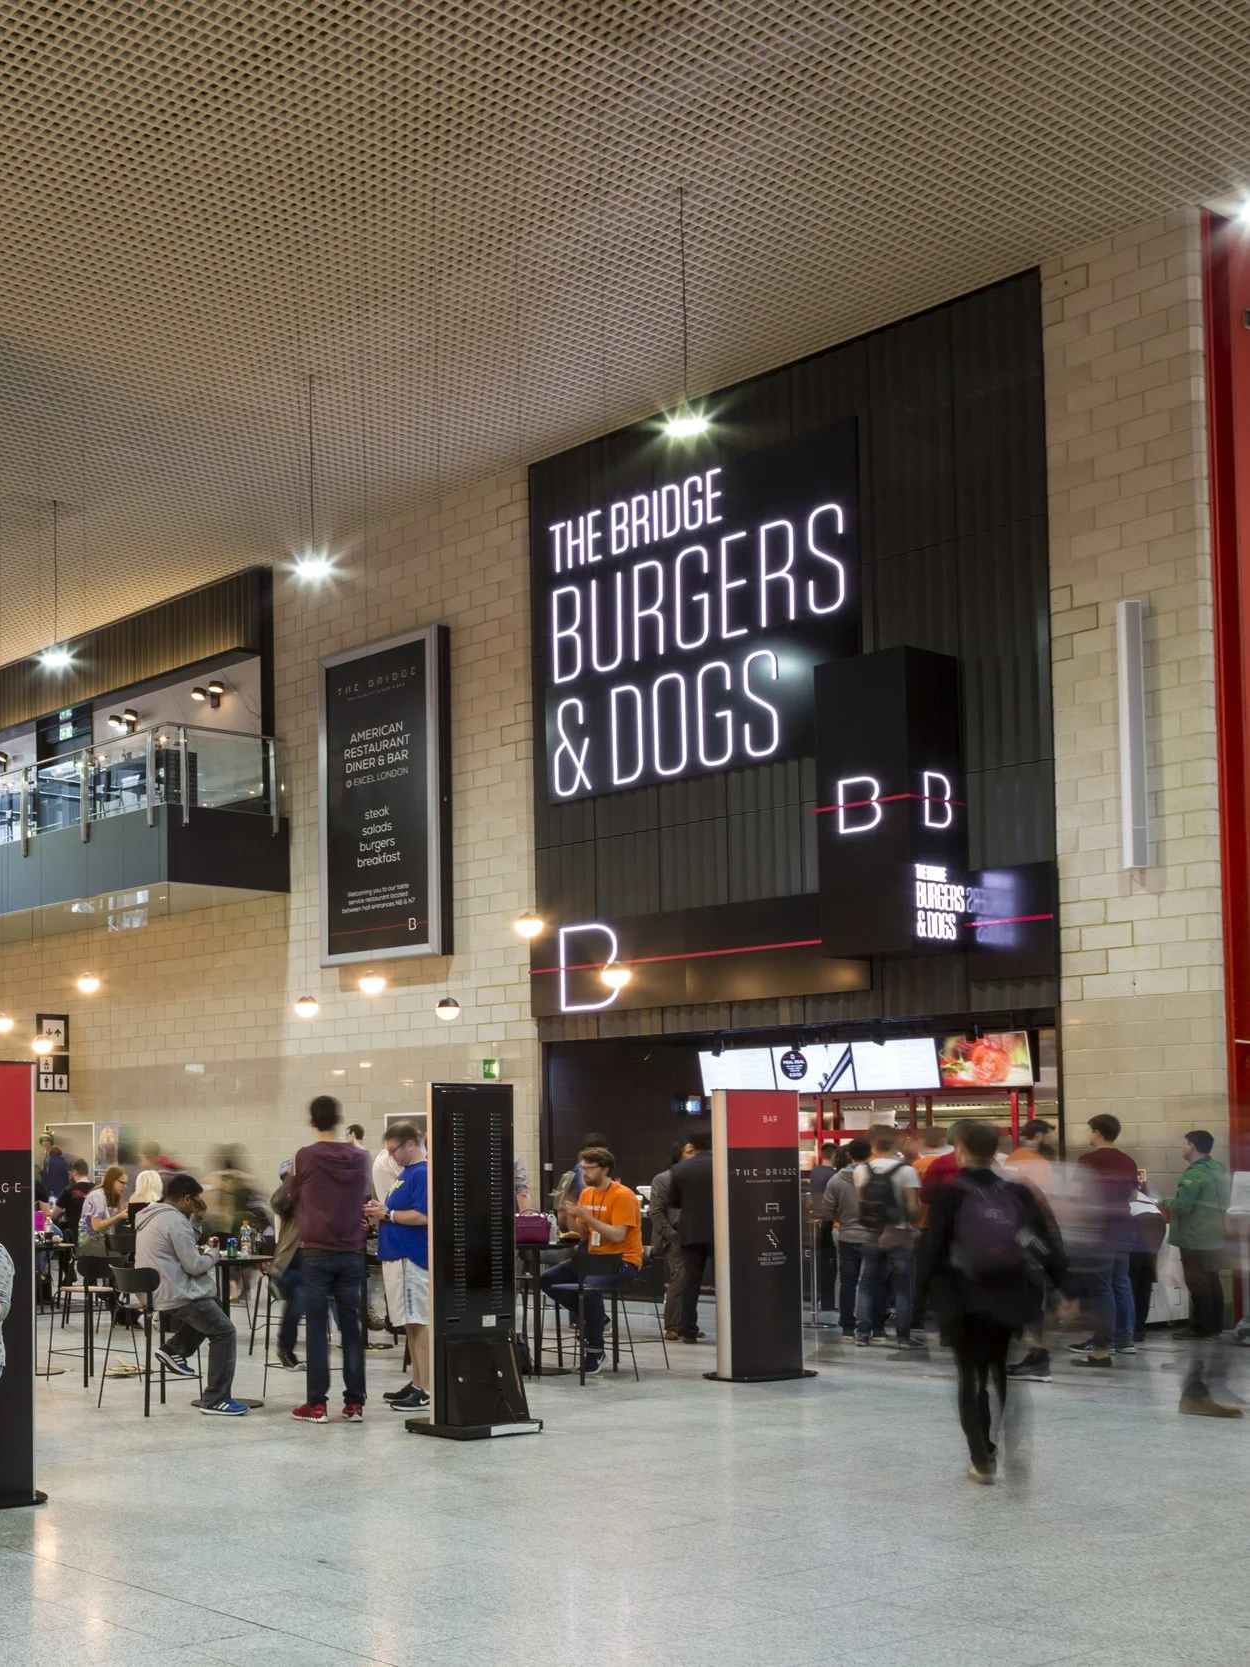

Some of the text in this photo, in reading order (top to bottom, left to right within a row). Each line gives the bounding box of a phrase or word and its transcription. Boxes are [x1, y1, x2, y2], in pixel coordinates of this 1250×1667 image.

[549, 467, 723, 574] THE BRIDGE
[552, 502, 846, 684] BURGERS
[337, 683, 359, 696] THE
[350, 720, 404, 744] AMERICAN
[553, 649, 780, 797] & DOGS
[344, 733, 411, 760] RESTAURANT
[345, 749, 409, 774] DINER & BAR
[376, 766, 410, 781] LONDON
[838, 776, 882, 834] B
[923, 771, 953, 829] B
[364, 804, 390, 820] steak
[362, 821, 393, 836] salads
[359, 837, 396, 853] burgers
[357, 851, 401, 868] breakfast
[346, 889, 372, 897] Welcoming
[348, 890, 409, 906] service restaurant located
[915, 880, 966, 913] BURGERS
[341, 906, 362, 914] between
[371, 901, 395, 910] entrances
[408, 917, 417, 931] B
[916, 909, 927, 938] &
[927, 911, 957, 940] DOGS
[559, 924, 620, 1012] B
[763, 1115, 778, 1123] BAR
